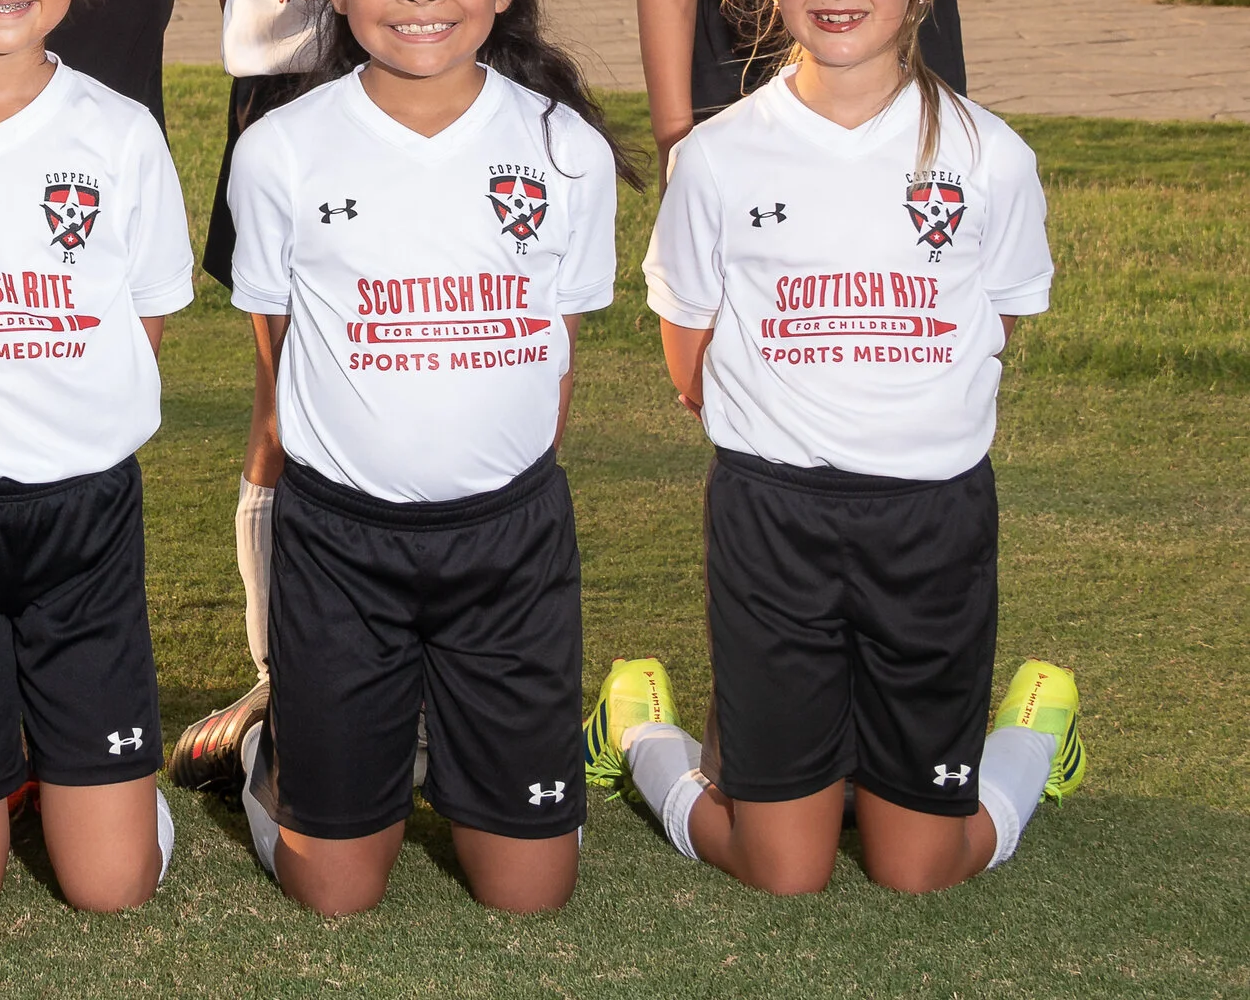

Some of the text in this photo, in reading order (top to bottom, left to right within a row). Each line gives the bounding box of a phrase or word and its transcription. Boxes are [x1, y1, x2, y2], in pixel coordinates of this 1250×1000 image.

[45, 172, 99, 189] COPPELL
[489, 164, 546, 182] COPPELL
[515, 241, 528, 255] FC
[928, 250, 942, 263] FC
[62, 251, 76, 265] FC
[22, 271, 75, 309] RITE
[357, 273, 530, 315] SCOTTISH RITE
[776, 272, 938, 312] SCOTTISH RITE
[384, 325, 500, 337] FOR CHILDREN
[795, 321, 907, 331] FOR CHILDREN
[349, 345, 548, 371] SPORTS MEDICINE
[761, 345, 953, 365] SPORTS MEDICINE
